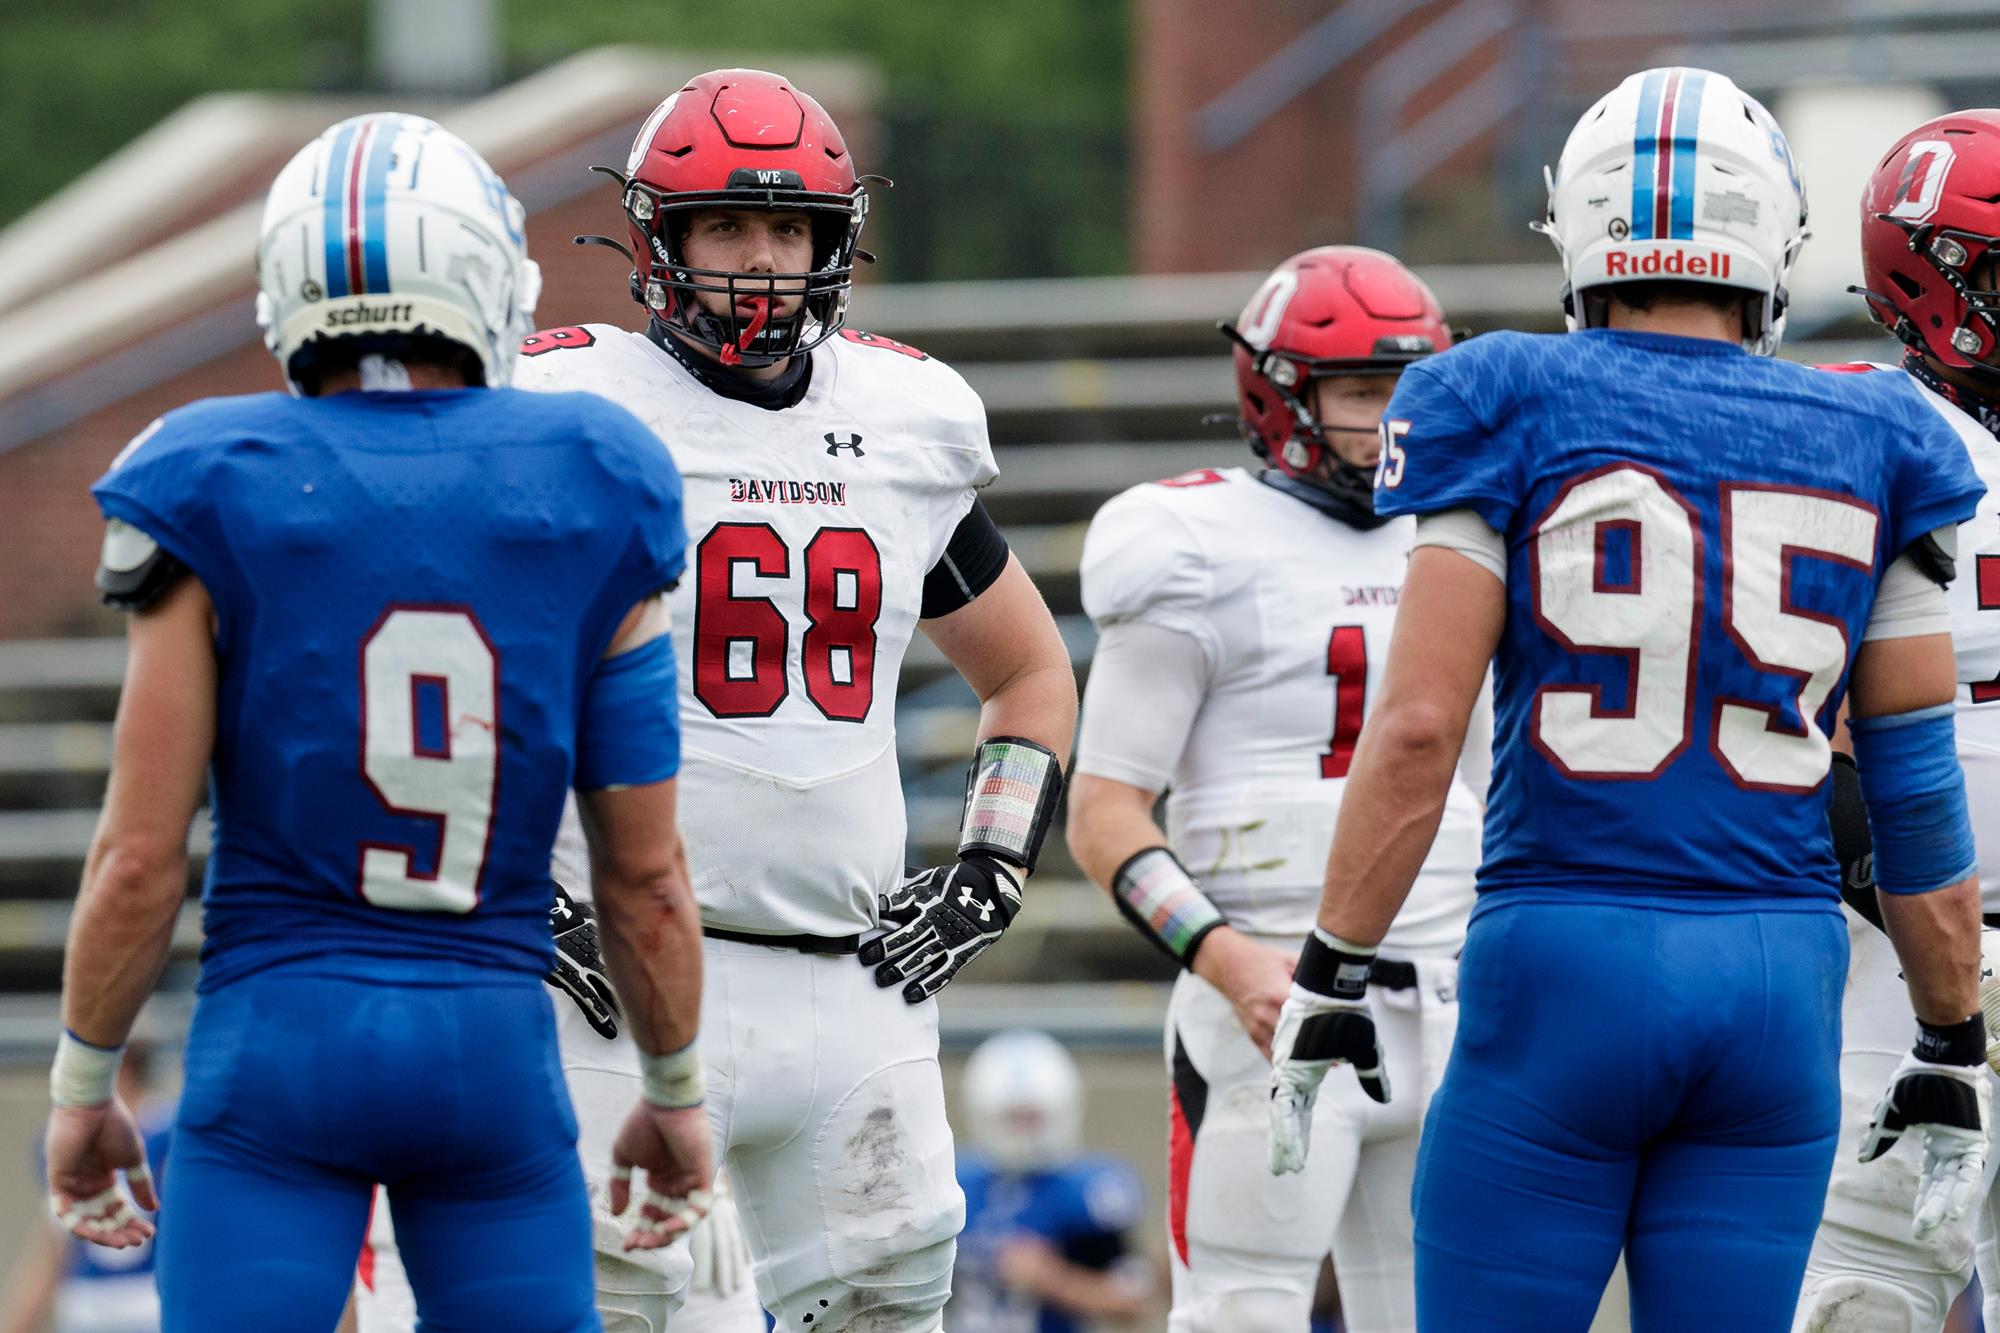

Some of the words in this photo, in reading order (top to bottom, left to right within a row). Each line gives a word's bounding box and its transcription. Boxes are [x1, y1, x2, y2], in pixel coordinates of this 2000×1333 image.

[756, 170, 782, 184] WE
[1887, 140, 1957, 225] D
[1605, 248, 1731, 279] Riddell
[326, 302, 414, 327] schutt
[729, 478, 846, 506] DAVIDSON
[692, 521, 883, 724] 68
[1530, 460, 1880, 796] 95
[357, 601, 501, 914] 9
